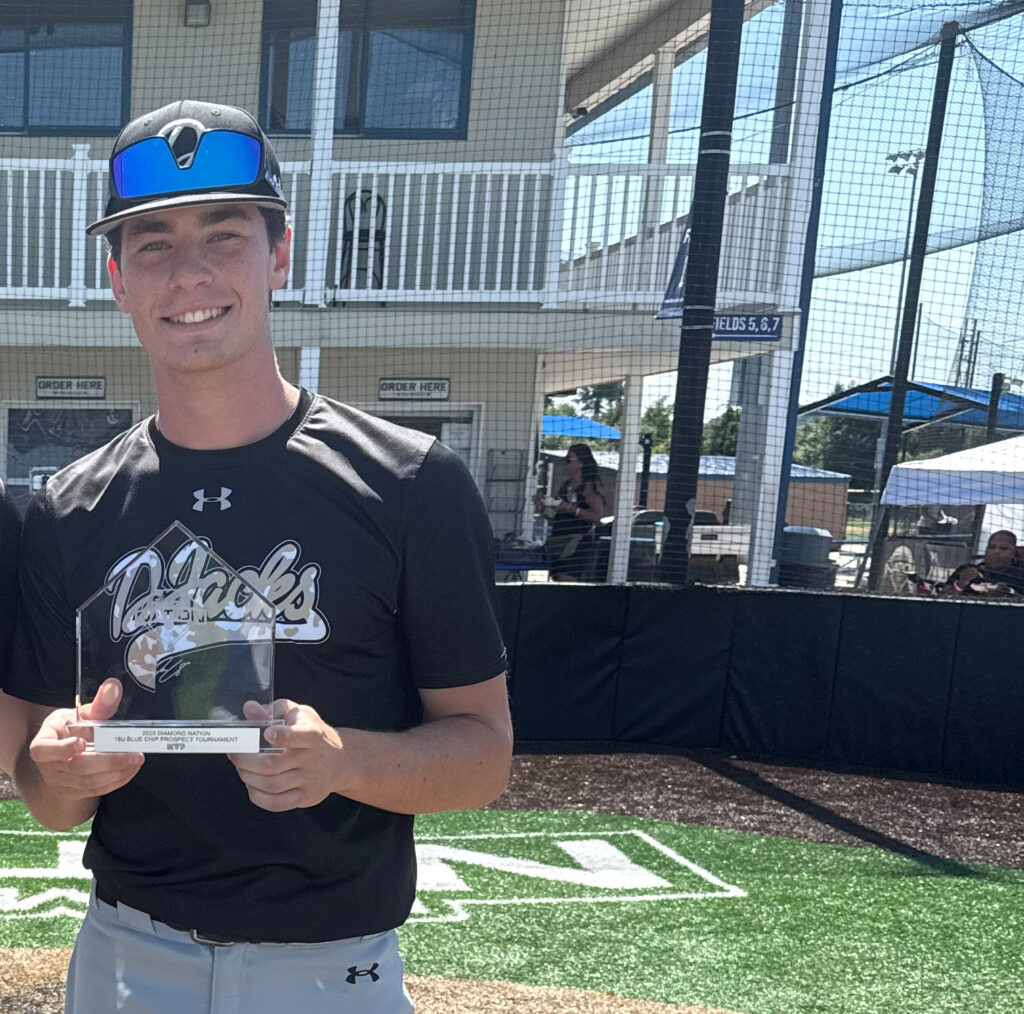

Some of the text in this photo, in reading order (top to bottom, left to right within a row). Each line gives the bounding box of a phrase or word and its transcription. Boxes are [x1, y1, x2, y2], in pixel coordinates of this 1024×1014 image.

[713, 316, 747, 331] IELDS
[772, 317, 780, 331] 7
[38, 380, 103, 390] ORDER HERE
[380, 382, 447, 391] ORDER HERE
